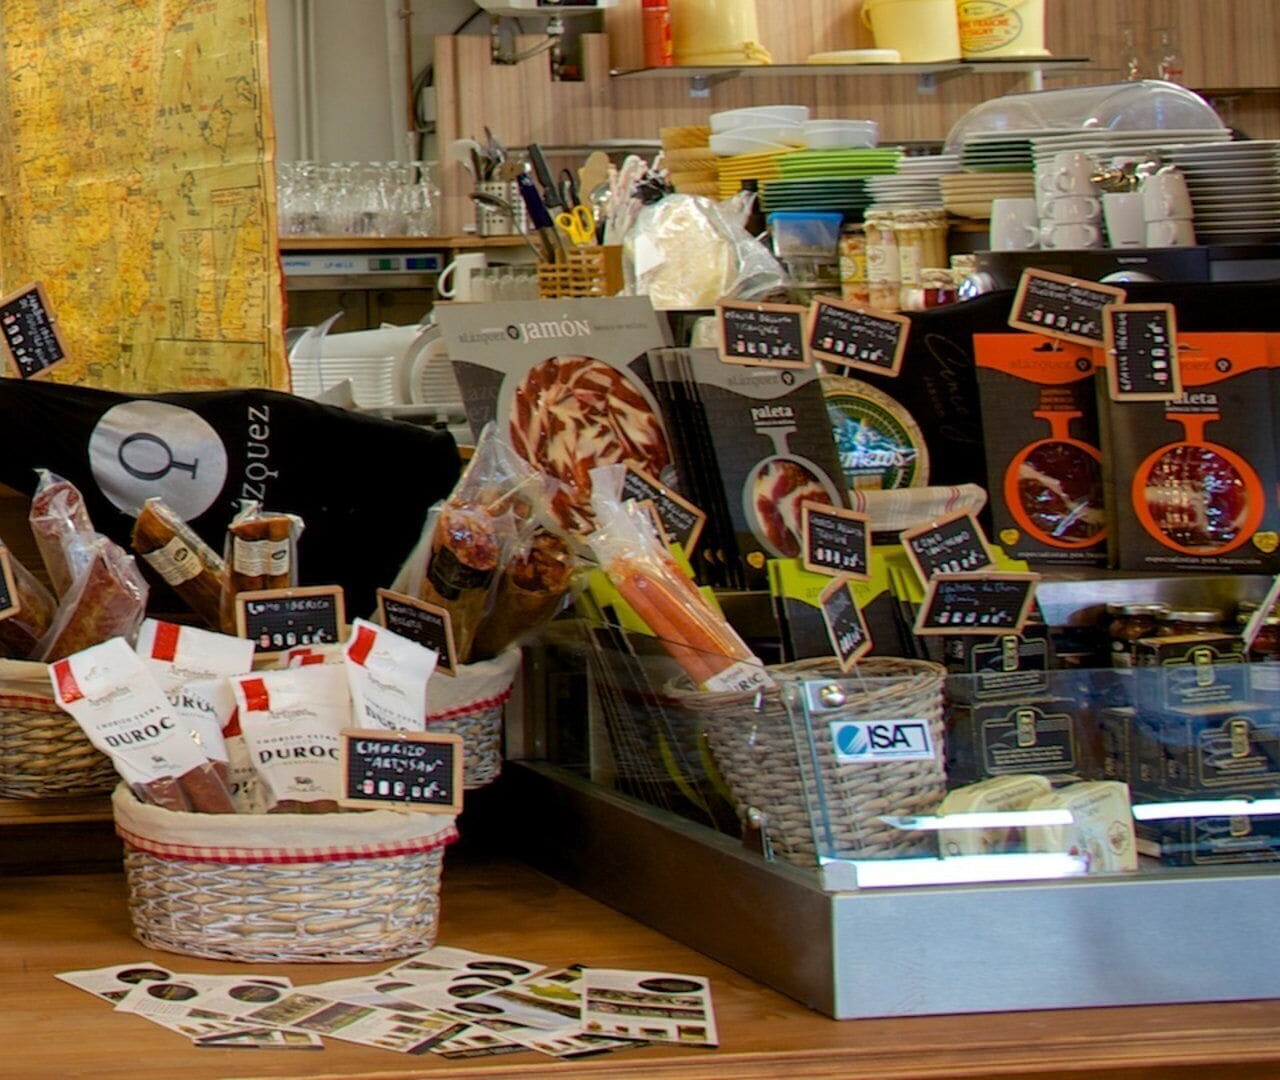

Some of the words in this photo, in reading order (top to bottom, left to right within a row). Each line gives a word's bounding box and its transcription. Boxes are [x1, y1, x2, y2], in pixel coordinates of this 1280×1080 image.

[104, 716, 176, 749] DUROC
[867, 725, 910, 749] ISA
[356, 741, 426, 757] CHORIZO
